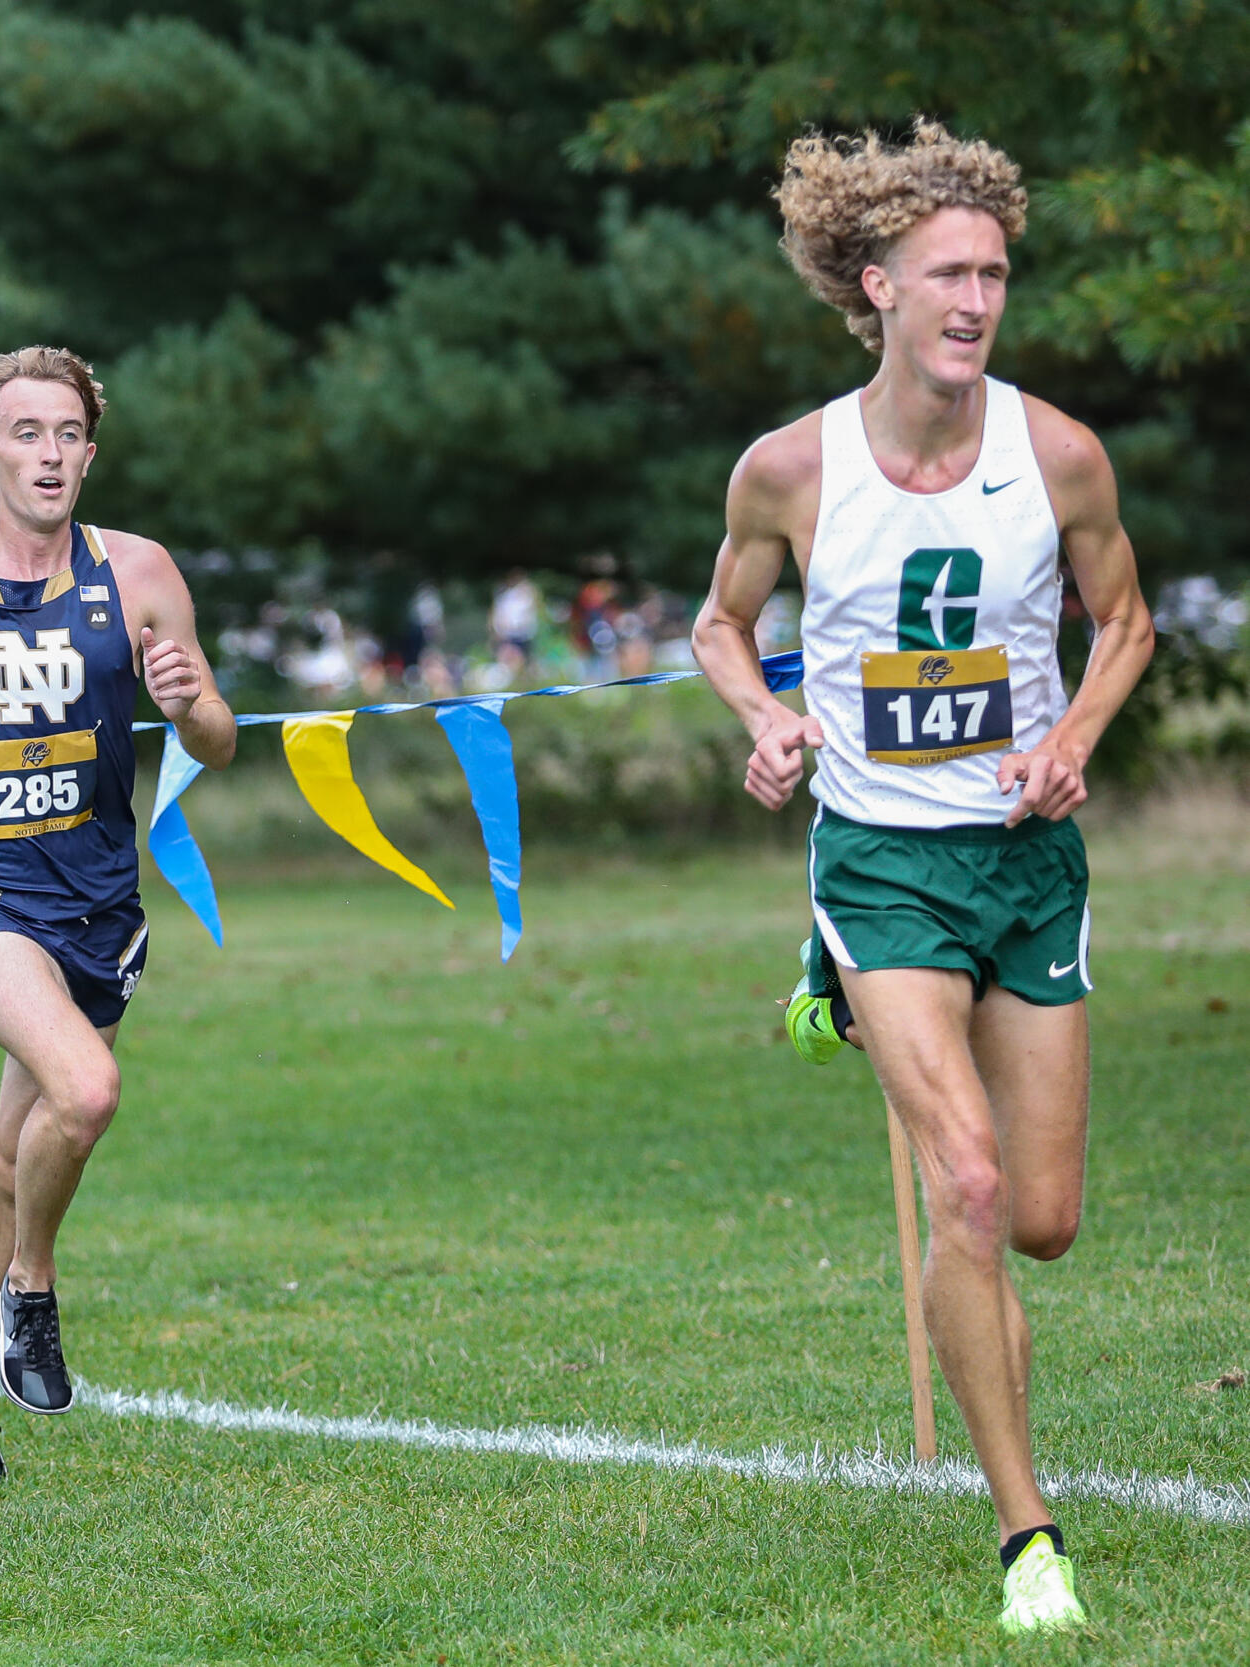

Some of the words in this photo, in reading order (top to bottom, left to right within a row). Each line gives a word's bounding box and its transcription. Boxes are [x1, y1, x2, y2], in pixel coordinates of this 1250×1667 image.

[897, 548, 983, 651] C
[91, 612, 107, 623] AB
[887, 690, 989, 743] 147
[14, 827, 42, 837] NOTRE
[43, 822, 67, 832] DAME
